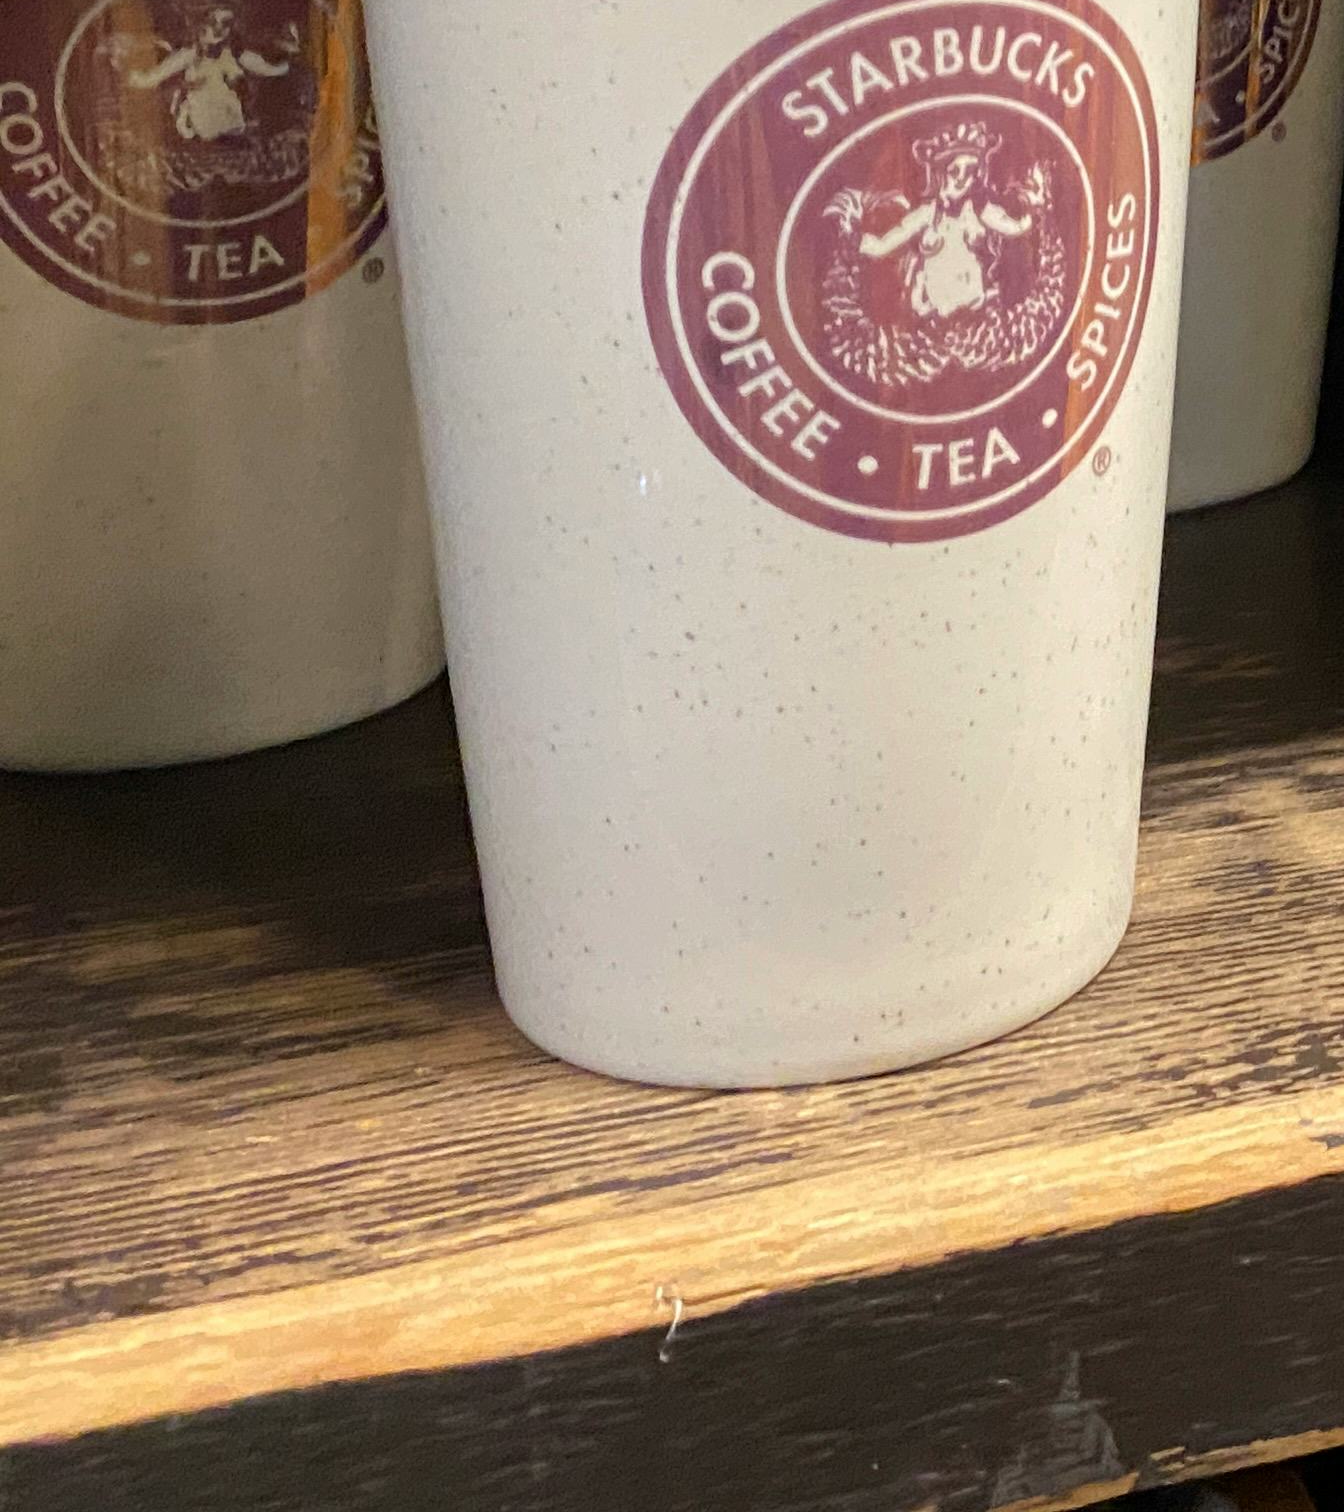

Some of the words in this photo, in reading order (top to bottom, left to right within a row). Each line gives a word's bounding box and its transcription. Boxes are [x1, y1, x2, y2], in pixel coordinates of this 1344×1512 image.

[780, 24, 1095, 138] STARBUCKS
[0, 81, 118, 254] COFFEE
[183, 234, 285, 283] TEA
[1065, 192, 1137, 390] SPICES
[700, 250, 841, 461] COFFEE
[911, 426, 1021, 490] TEA
